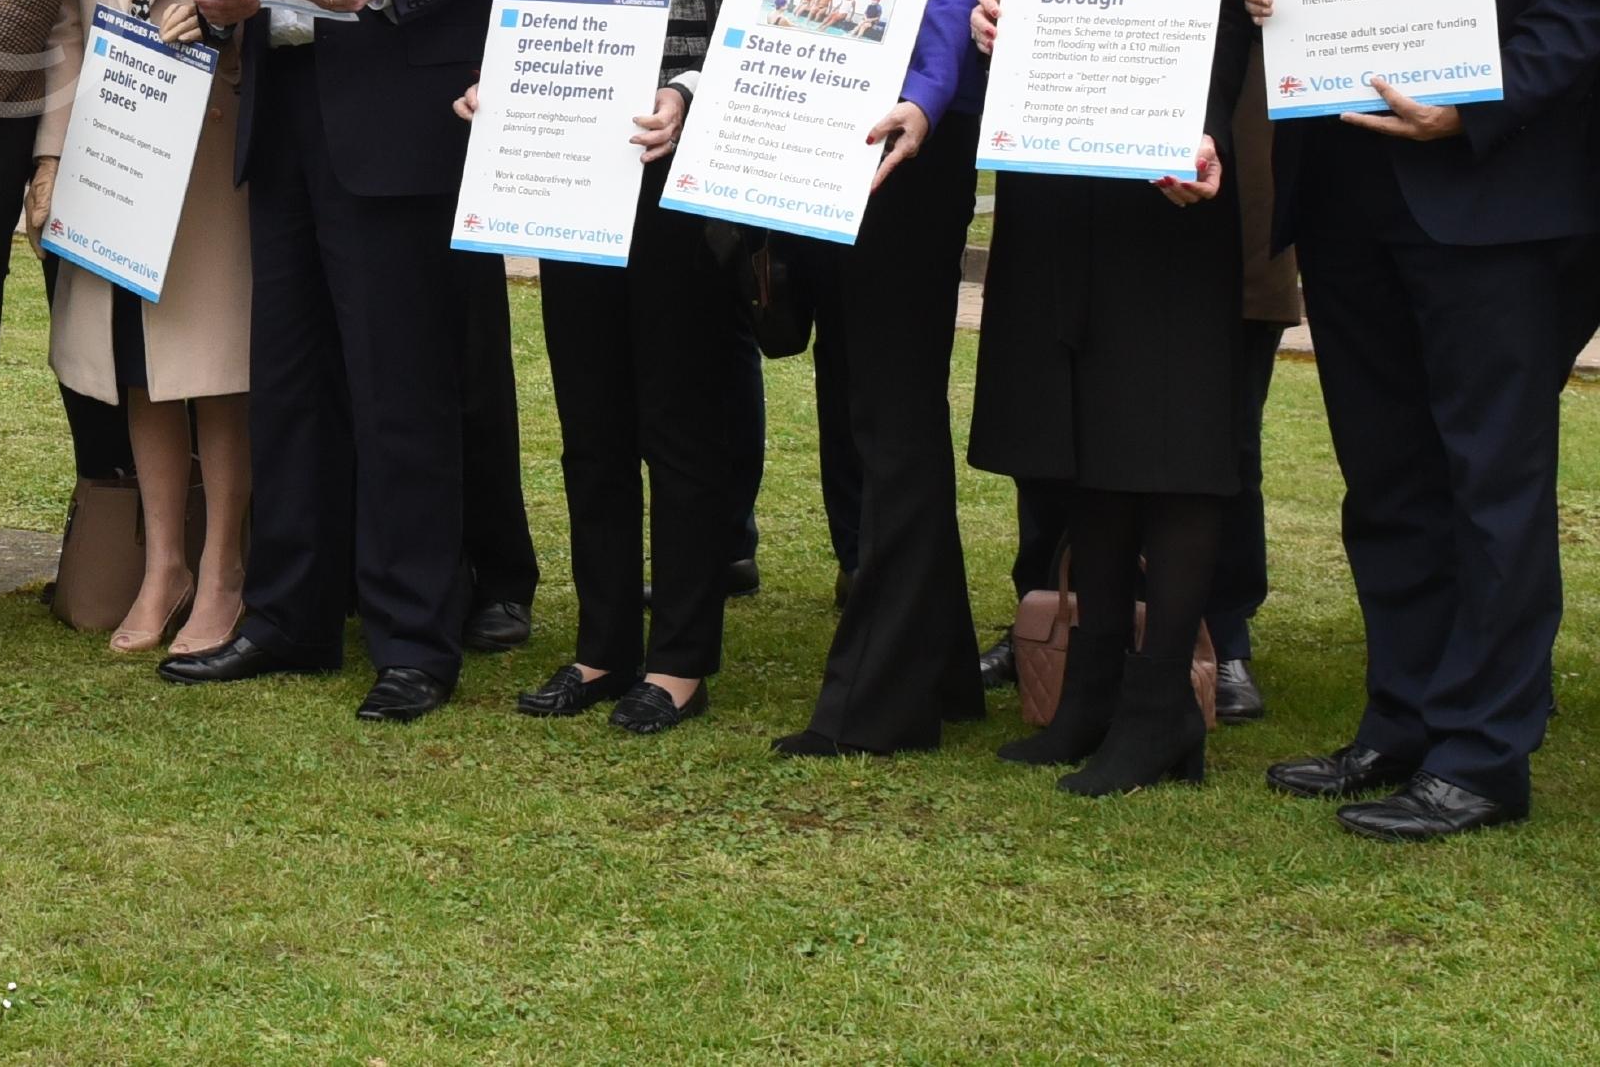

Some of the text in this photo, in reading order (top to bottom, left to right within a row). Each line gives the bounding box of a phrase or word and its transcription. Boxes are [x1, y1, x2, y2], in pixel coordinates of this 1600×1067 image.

[521, 12, 608, 32] Defend the
[517, 37, 635, 56] greenbelt from
[746, 34, 847, 65] State of the
[108, 44, 177, 85] Enhance our
[513, 59, 604, 77] speculative
[740, 60, 871, 92] art new leisure
[102, 68, 168, 104] public open
[510, 78, 614, 101] development
[733, 77, 807, 104] facilities
[98, 87, 137, 112] spaces
[1023, 100, 1186, 118] Promote on street and car park EV
